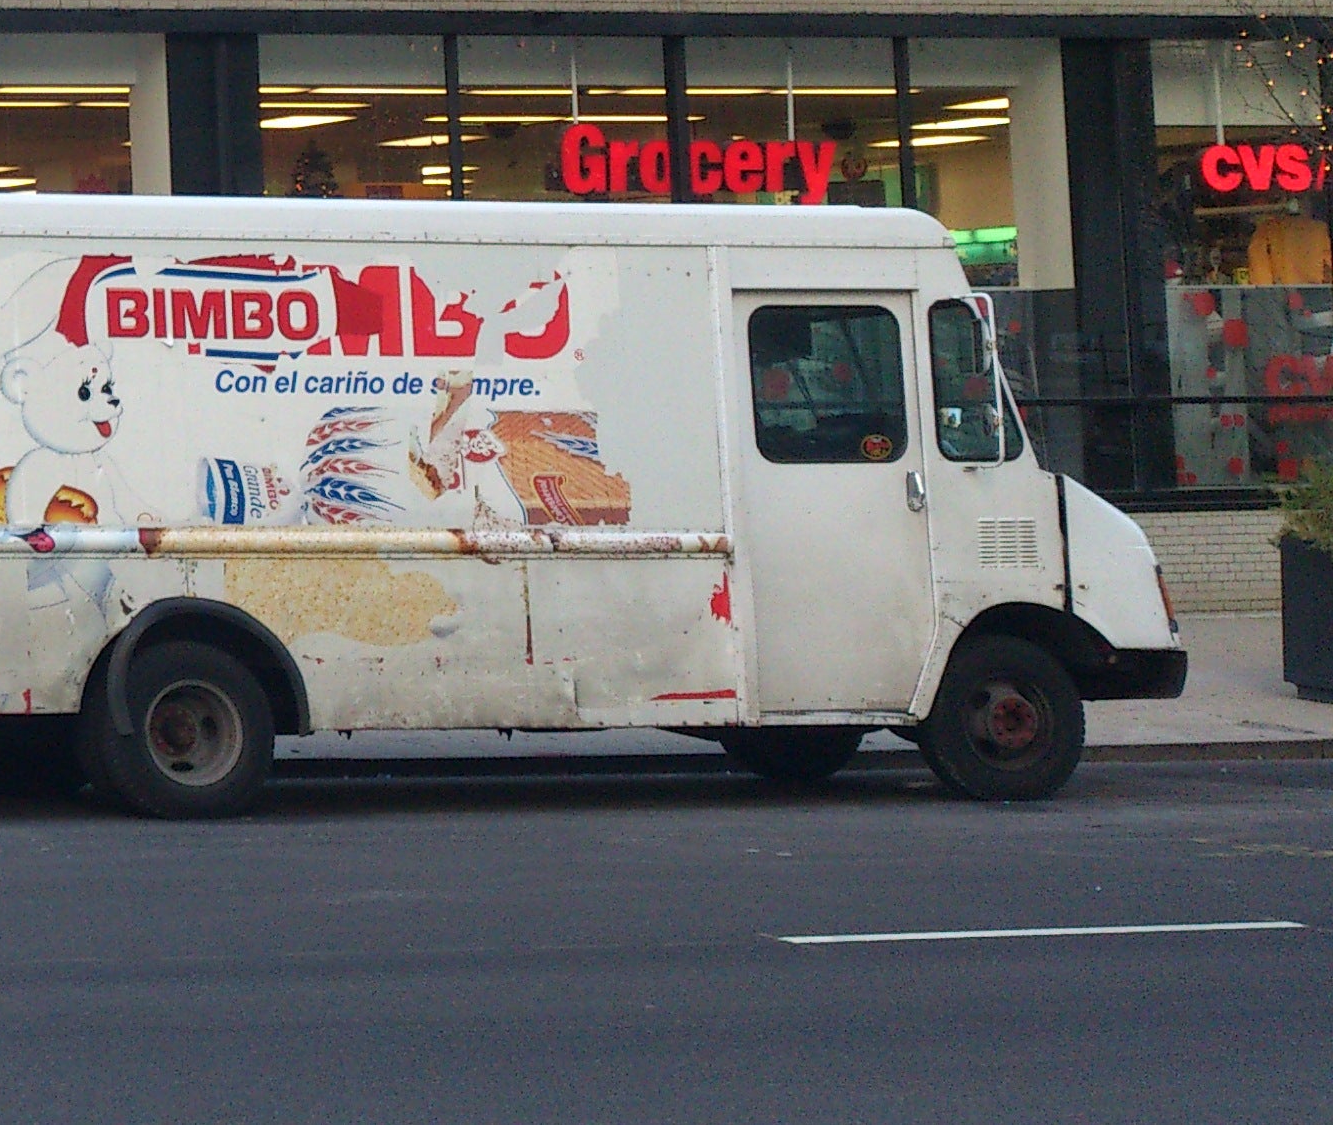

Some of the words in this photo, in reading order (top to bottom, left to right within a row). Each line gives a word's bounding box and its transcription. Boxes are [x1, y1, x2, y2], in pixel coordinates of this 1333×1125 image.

[561, 124, 837, 205] Grocery
[106, 287, 319, 340] BIMBO
[214, 370, 267, 394] Con
[274, 370, 298, 394] el
[304, 371, 385, 395] cariño
[392, 372, 424, 395] de
[242, 465, 266, 519] Grande
